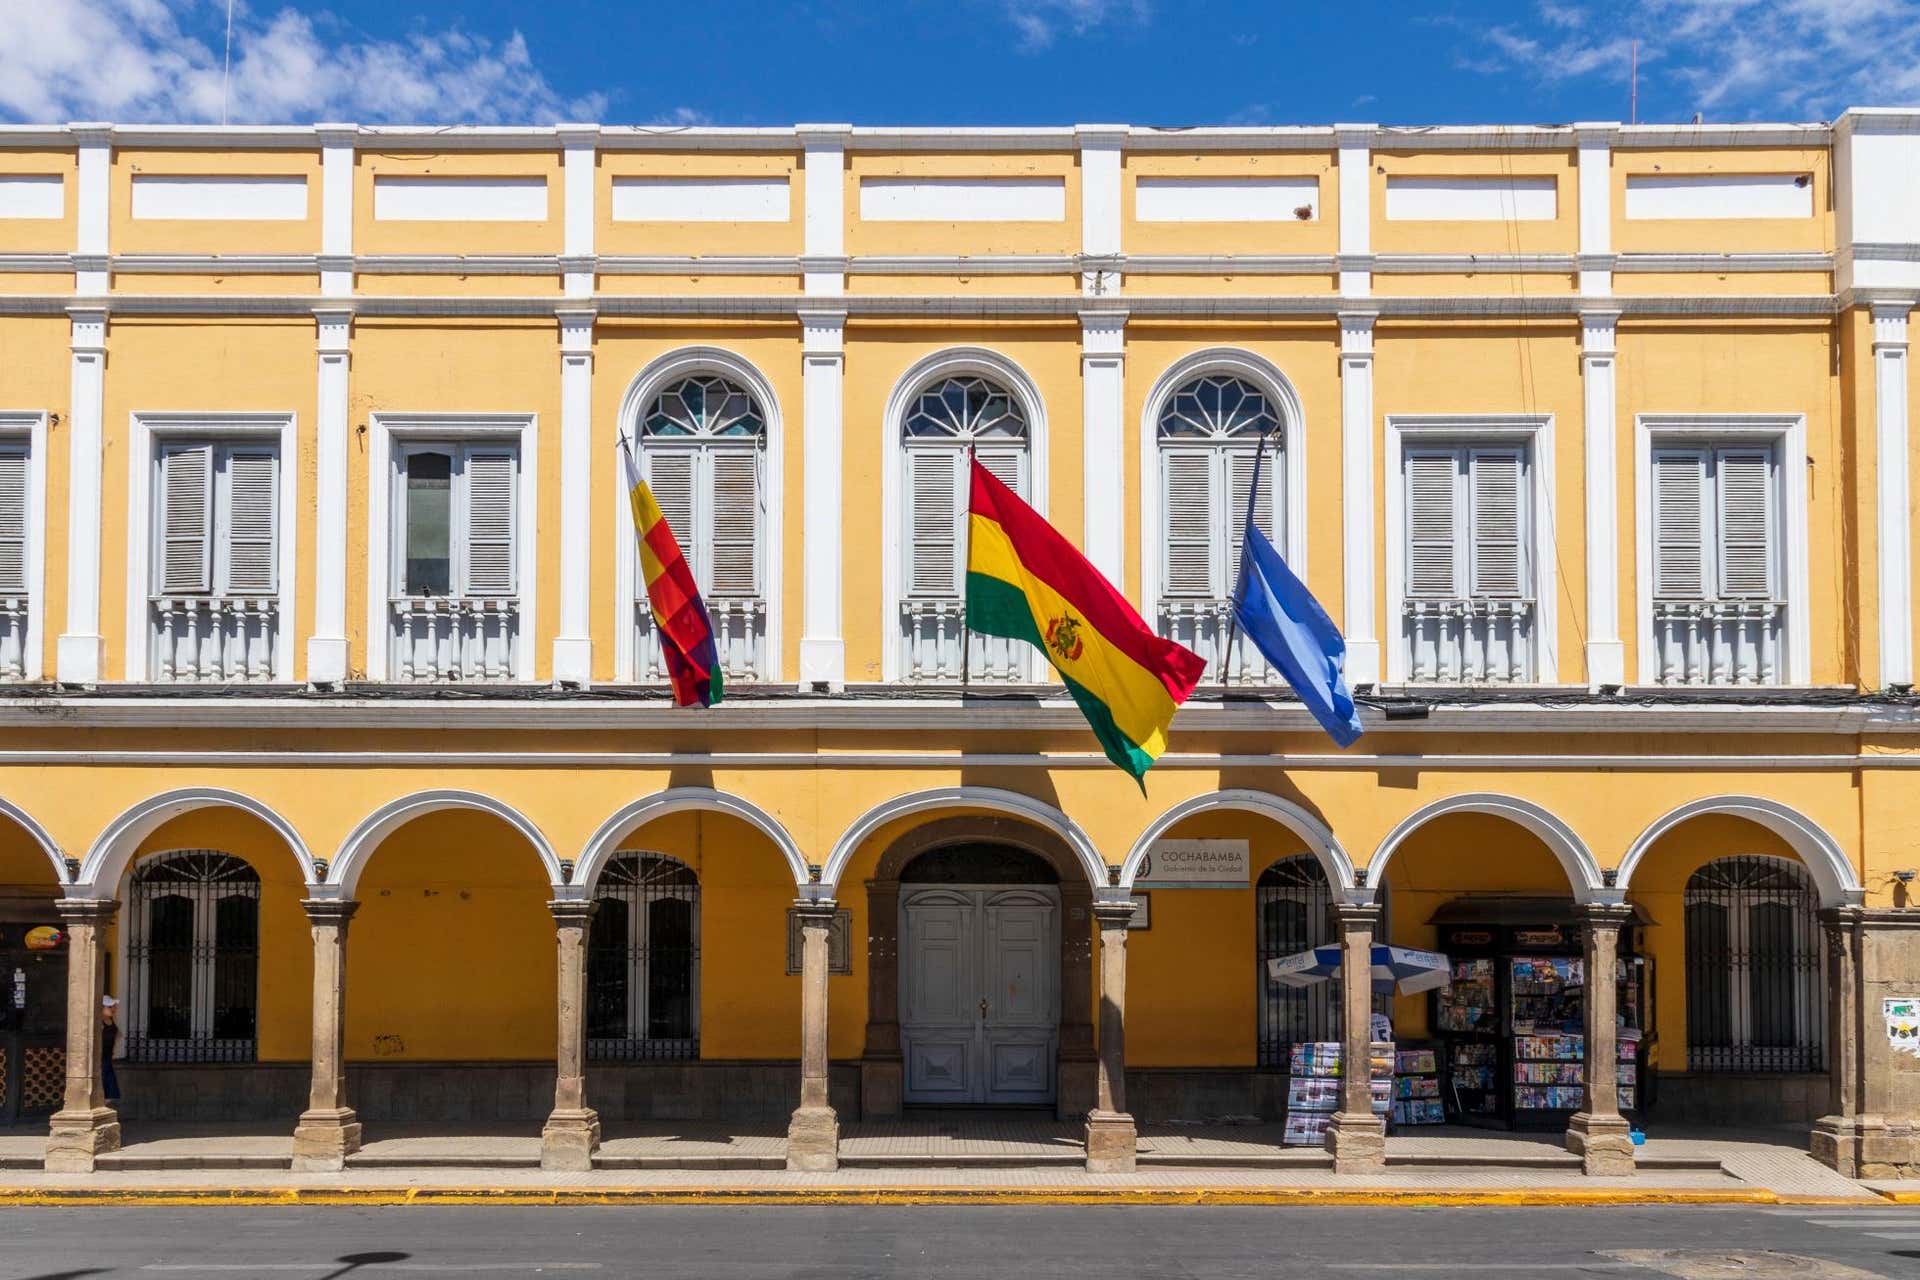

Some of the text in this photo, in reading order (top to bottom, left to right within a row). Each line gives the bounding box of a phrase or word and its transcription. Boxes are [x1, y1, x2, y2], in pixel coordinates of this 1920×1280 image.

[1161, 851, 1242, 861] COCHABAMBA
[1163, 864, 1243, 872] Gobierno de la Ciudad
